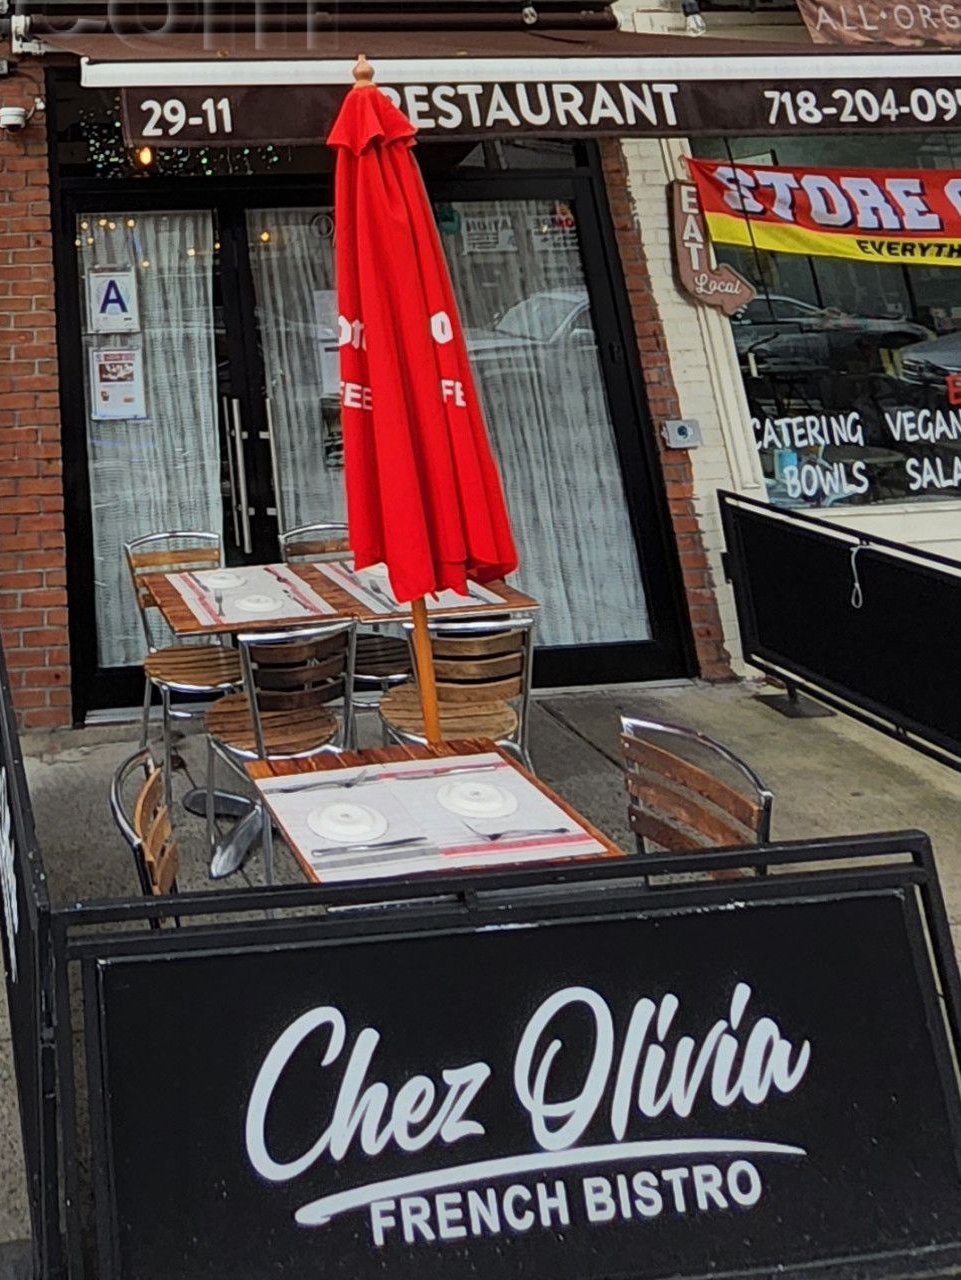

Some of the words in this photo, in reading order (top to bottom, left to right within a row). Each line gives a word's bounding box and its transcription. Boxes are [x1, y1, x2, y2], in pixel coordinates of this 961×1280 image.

[140, 96, 233, 138] 29-11
[764, 87, 961, 126] 718-204-09
[714, 166, 942, 231] STORE
[681, 185, 704, 271] EAT
[99, 279, 129, 314] A
[694, 273, 742, 295] Local
[751, 410, 865, 451] CATERING
[783, 460, 870, 498] BOWLS
[246, 1005, 491, 1182] Chez
[513, 982, 811, 1152] Olivia
[369, 1180, 570, 1248] FRENCH
[583, 1159, 764, 1225] BISTRO
